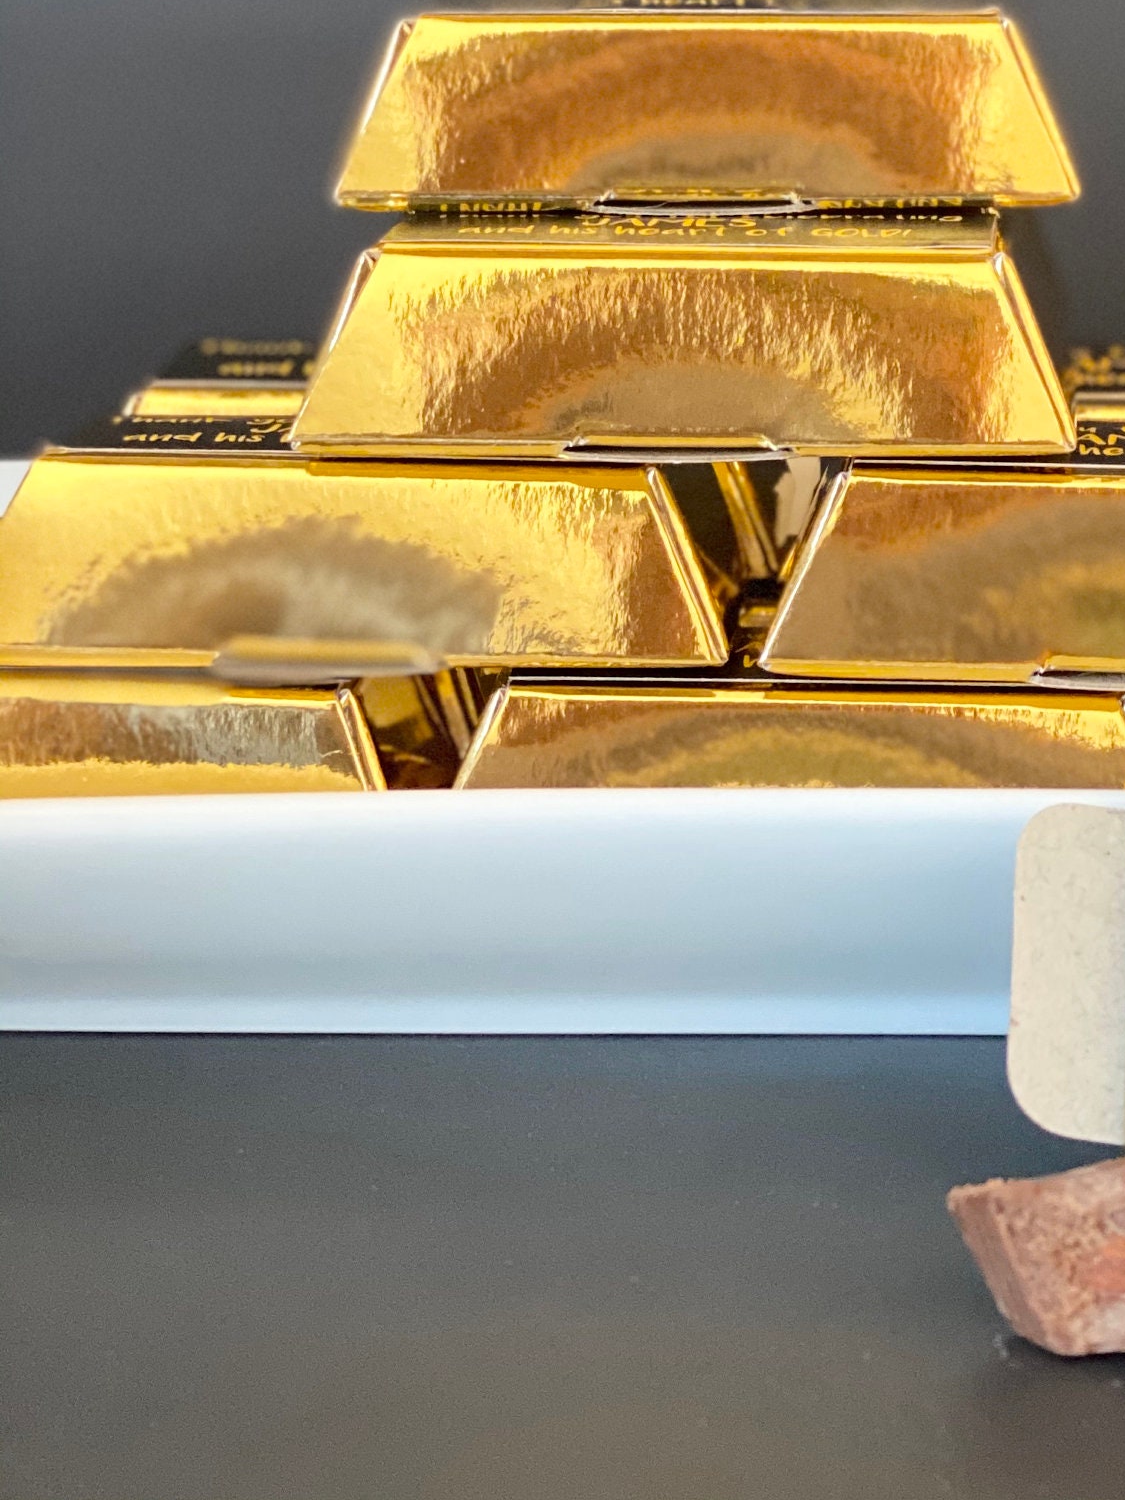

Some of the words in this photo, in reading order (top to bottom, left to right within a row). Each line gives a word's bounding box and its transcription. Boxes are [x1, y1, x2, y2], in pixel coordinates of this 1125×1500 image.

[457, 224, 535, 235] and
[549, 224, 599, 235] his
[122, 431, 203, 443] and
[214, 431, 266, 443] his
